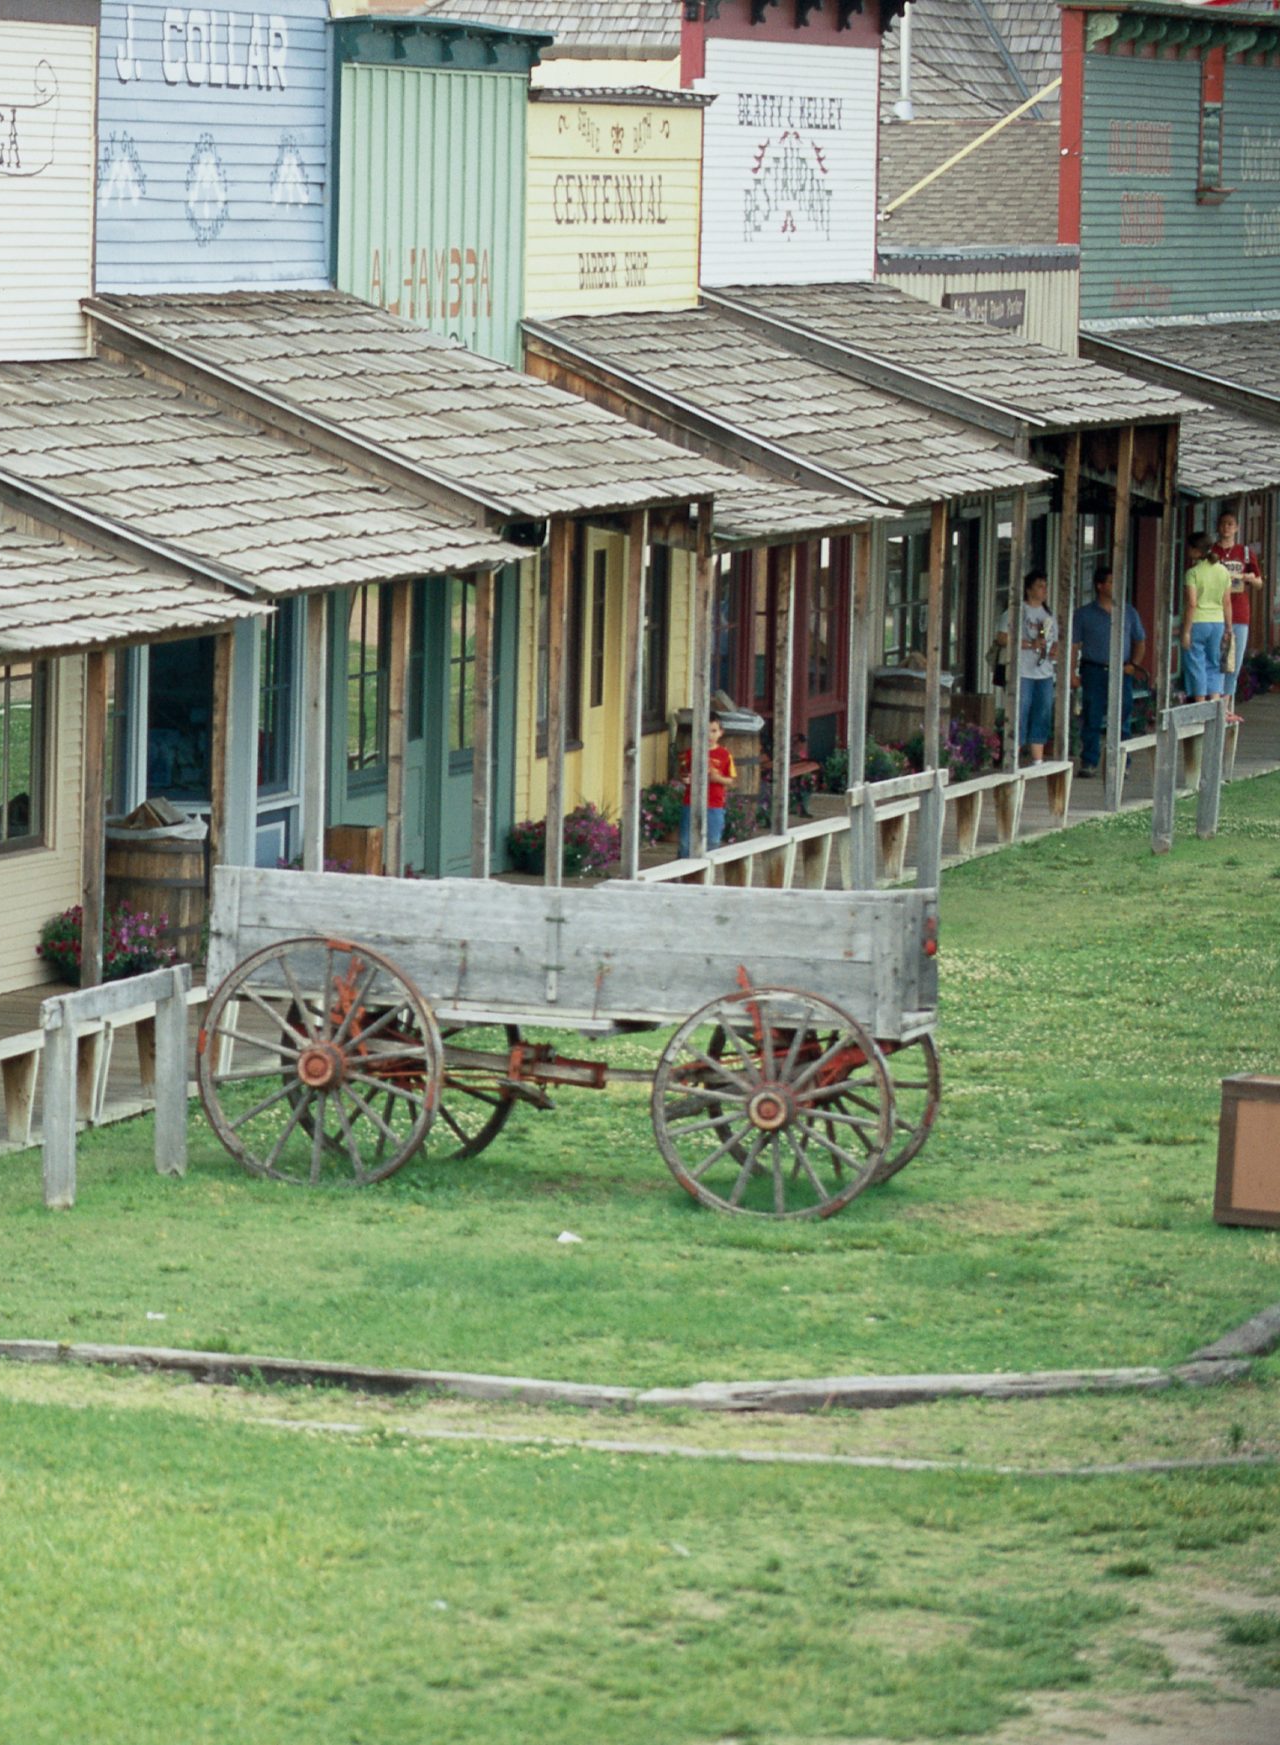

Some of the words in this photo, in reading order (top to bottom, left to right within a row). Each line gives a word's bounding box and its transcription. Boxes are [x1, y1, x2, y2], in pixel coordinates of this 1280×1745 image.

[115, 3, 142, 85] J.
[161, 6, 289, 91] COLLAR
[553, 173, 668, 225] CENTENNIAL
[370, 247, 492, 319] ALHAMBRA
